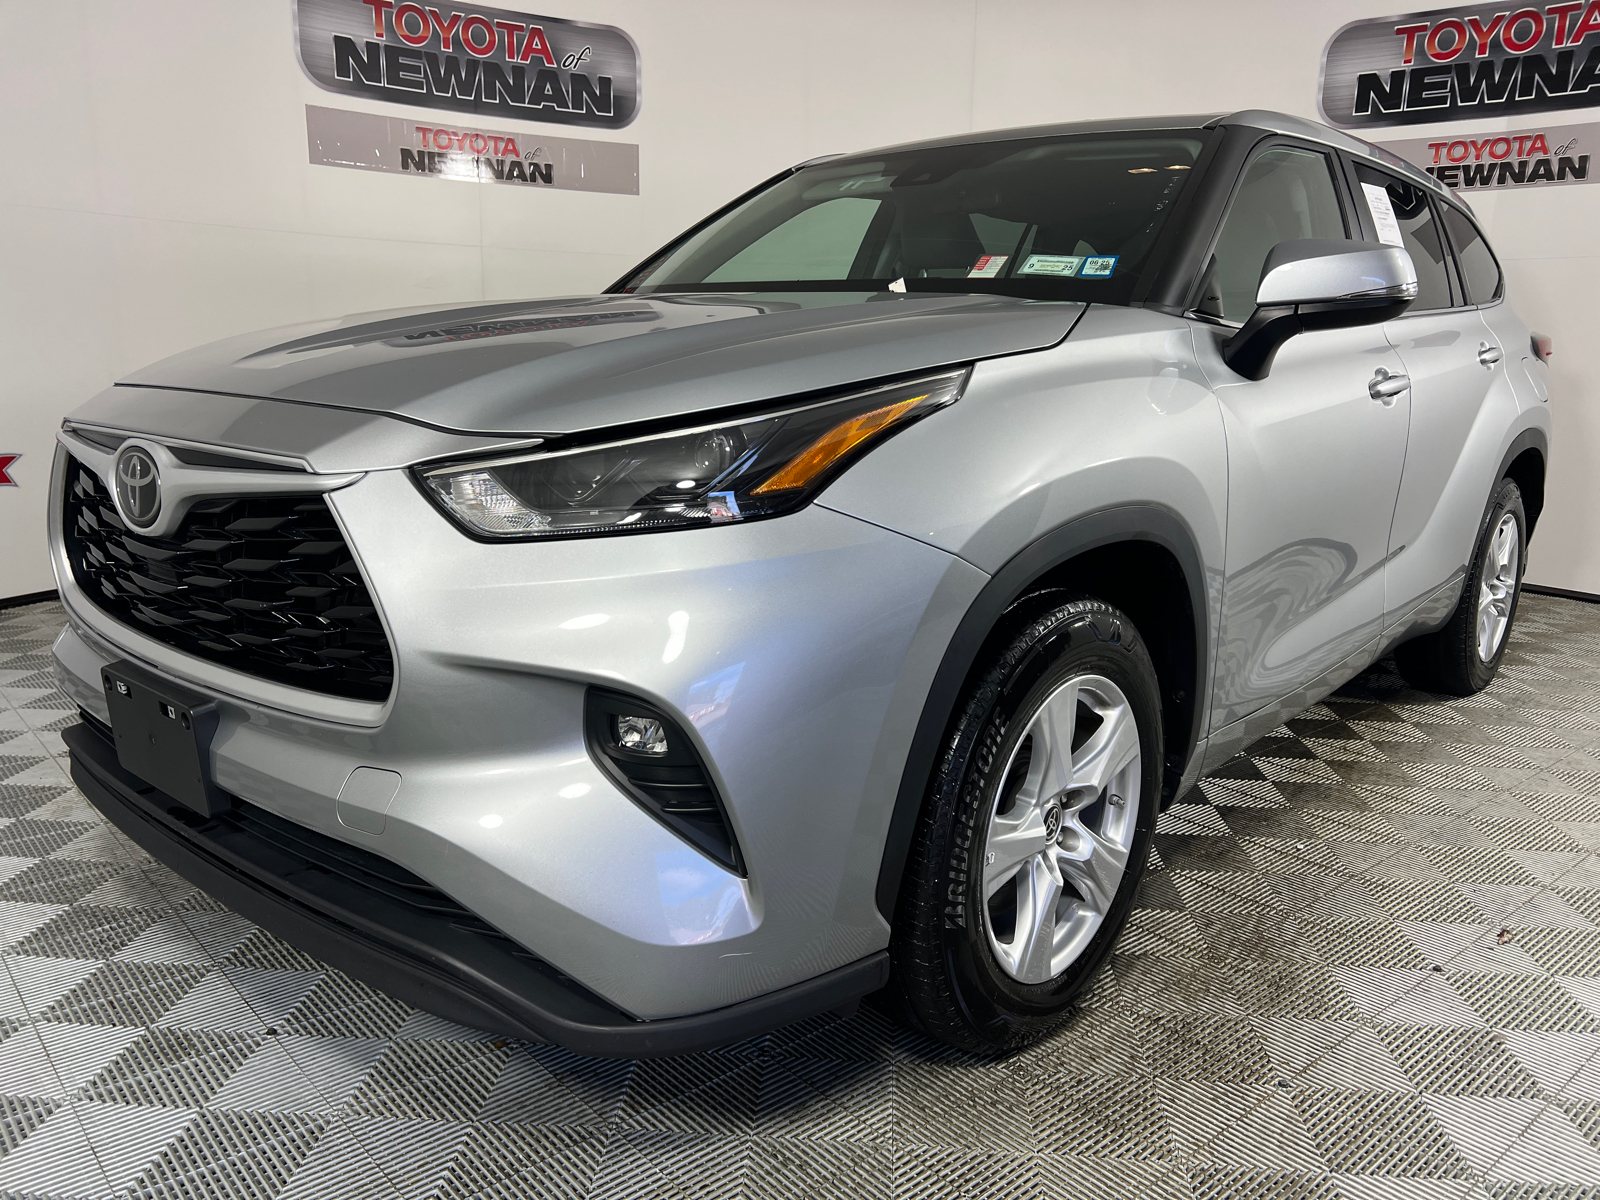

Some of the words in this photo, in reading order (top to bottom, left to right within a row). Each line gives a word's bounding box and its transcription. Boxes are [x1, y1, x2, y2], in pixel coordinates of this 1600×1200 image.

[362, 0, 557, 68] TOYOTA
[561, 46, 591, 70] of
[1394, 0, 1600, 66] TOYOTA
[333, 34, 613, 116] NEWNAN
[400, 147, 554, 186] NENAN
[415, 126, 521, 159] TOYOTA
[524, 147, 541, 161] of
[1427, 133, 1550, 165] TOYOTA
[1554, 137, 1579, 157] of
[943, 705, 1012, 930] BRIDGESTONE
